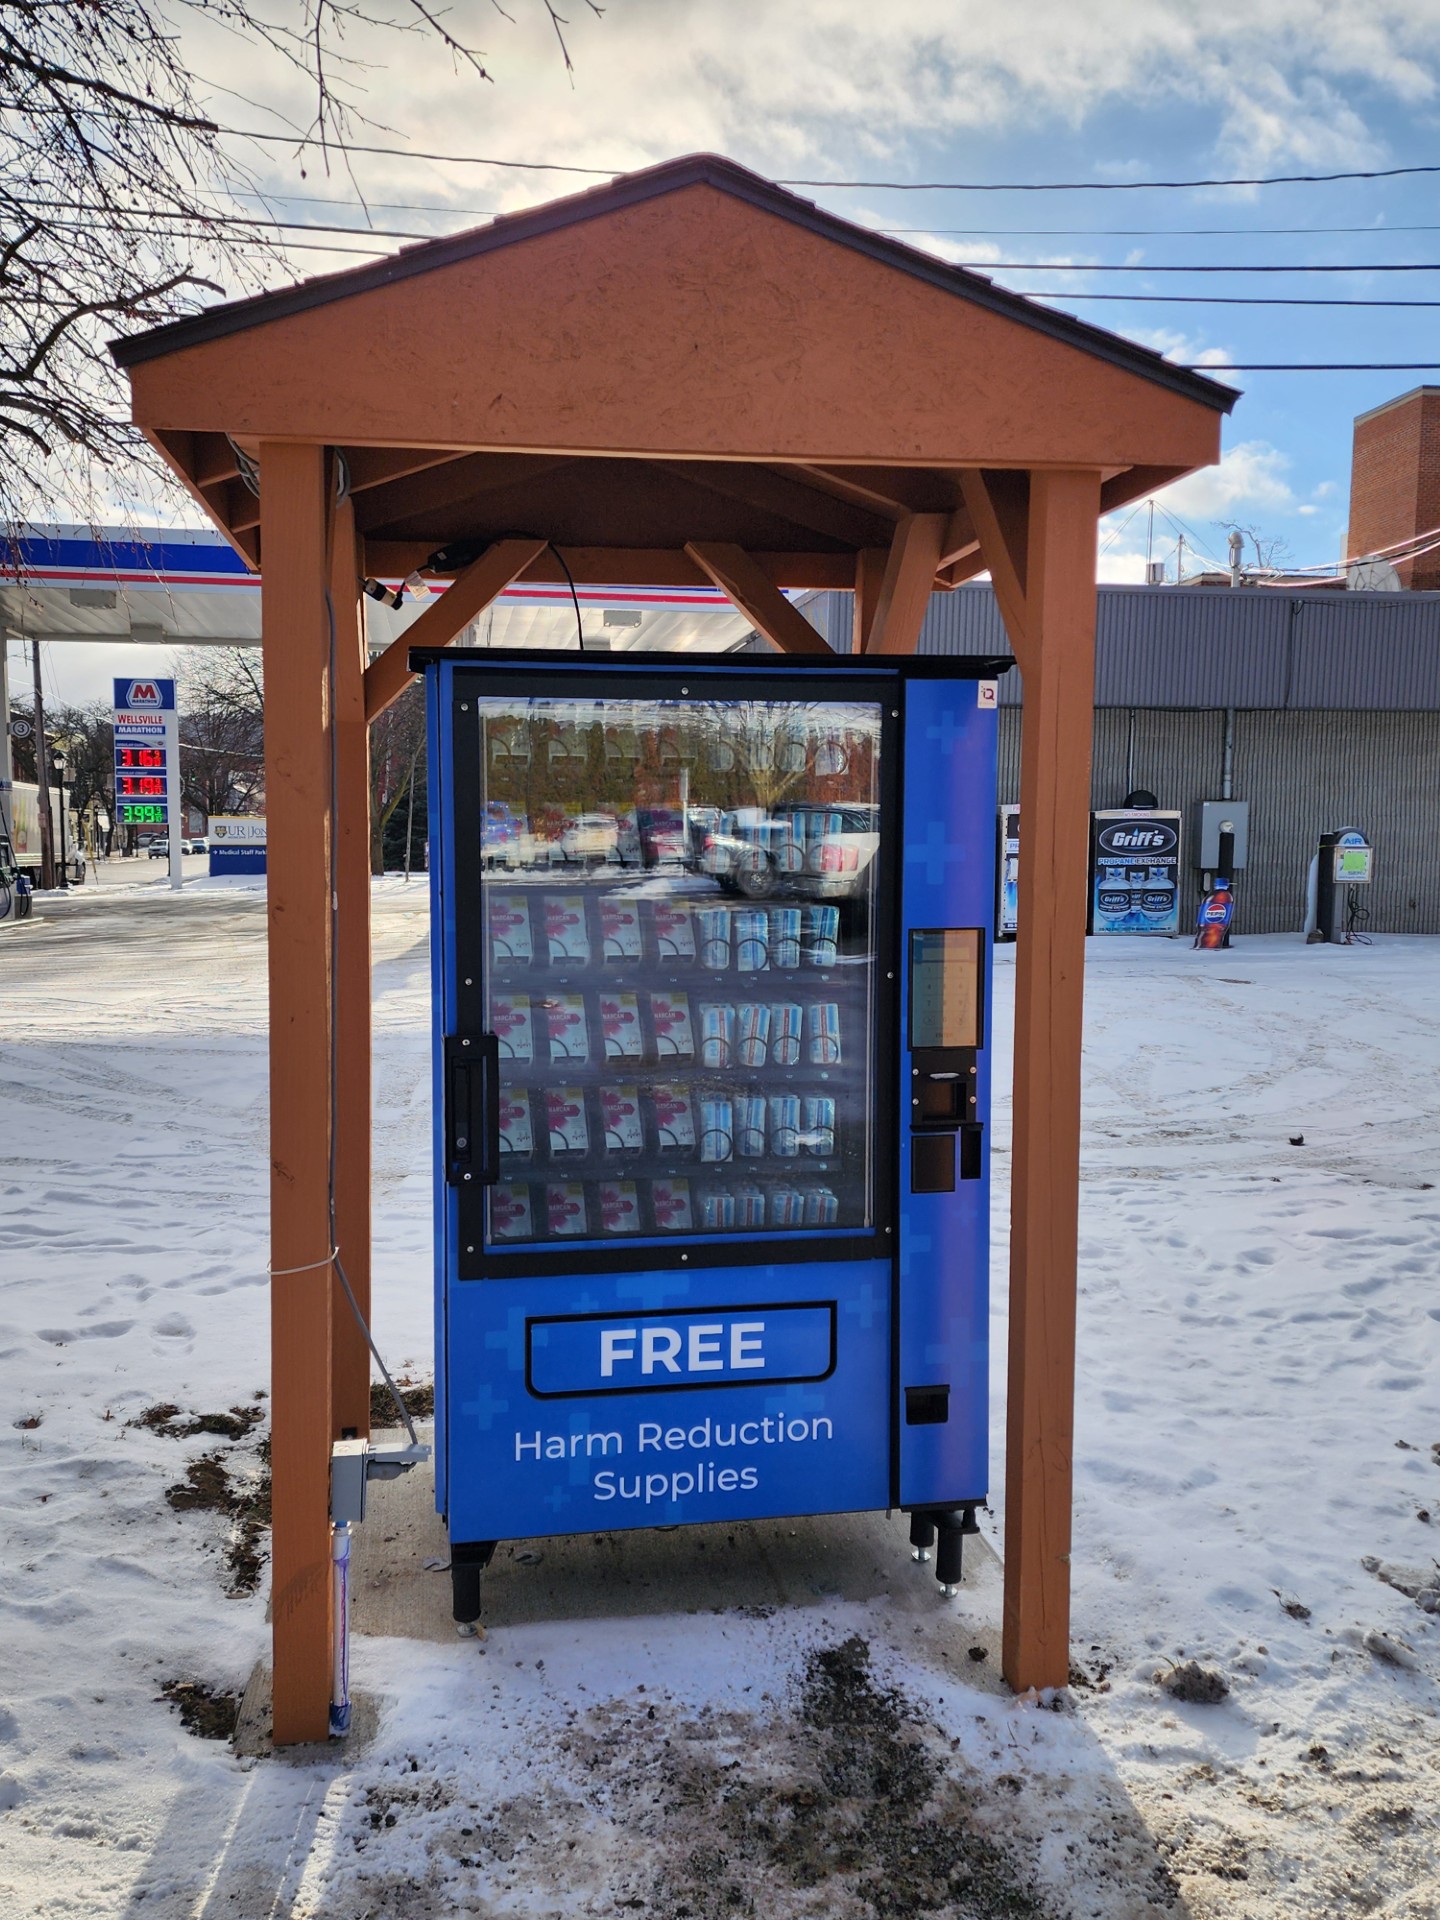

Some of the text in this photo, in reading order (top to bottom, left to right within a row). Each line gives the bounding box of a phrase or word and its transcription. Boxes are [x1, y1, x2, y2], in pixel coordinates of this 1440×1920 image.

[132, 684, 156, 698] M
[117, 714, 163, 724] WELLSVILLE
[228, 826, 246, 836] UR
[1112, 828, 1165, 846] Griff's
[1098, 857, 1177, 866] PROPANE EXCHANGE
[1104, 895, 1125, 903] Griff's
[599, 1321, 766, 1377] FREE
[514, 1411, 834, 1462] Harm Reduction
[593, 1461, 759, 1504] Supplies
